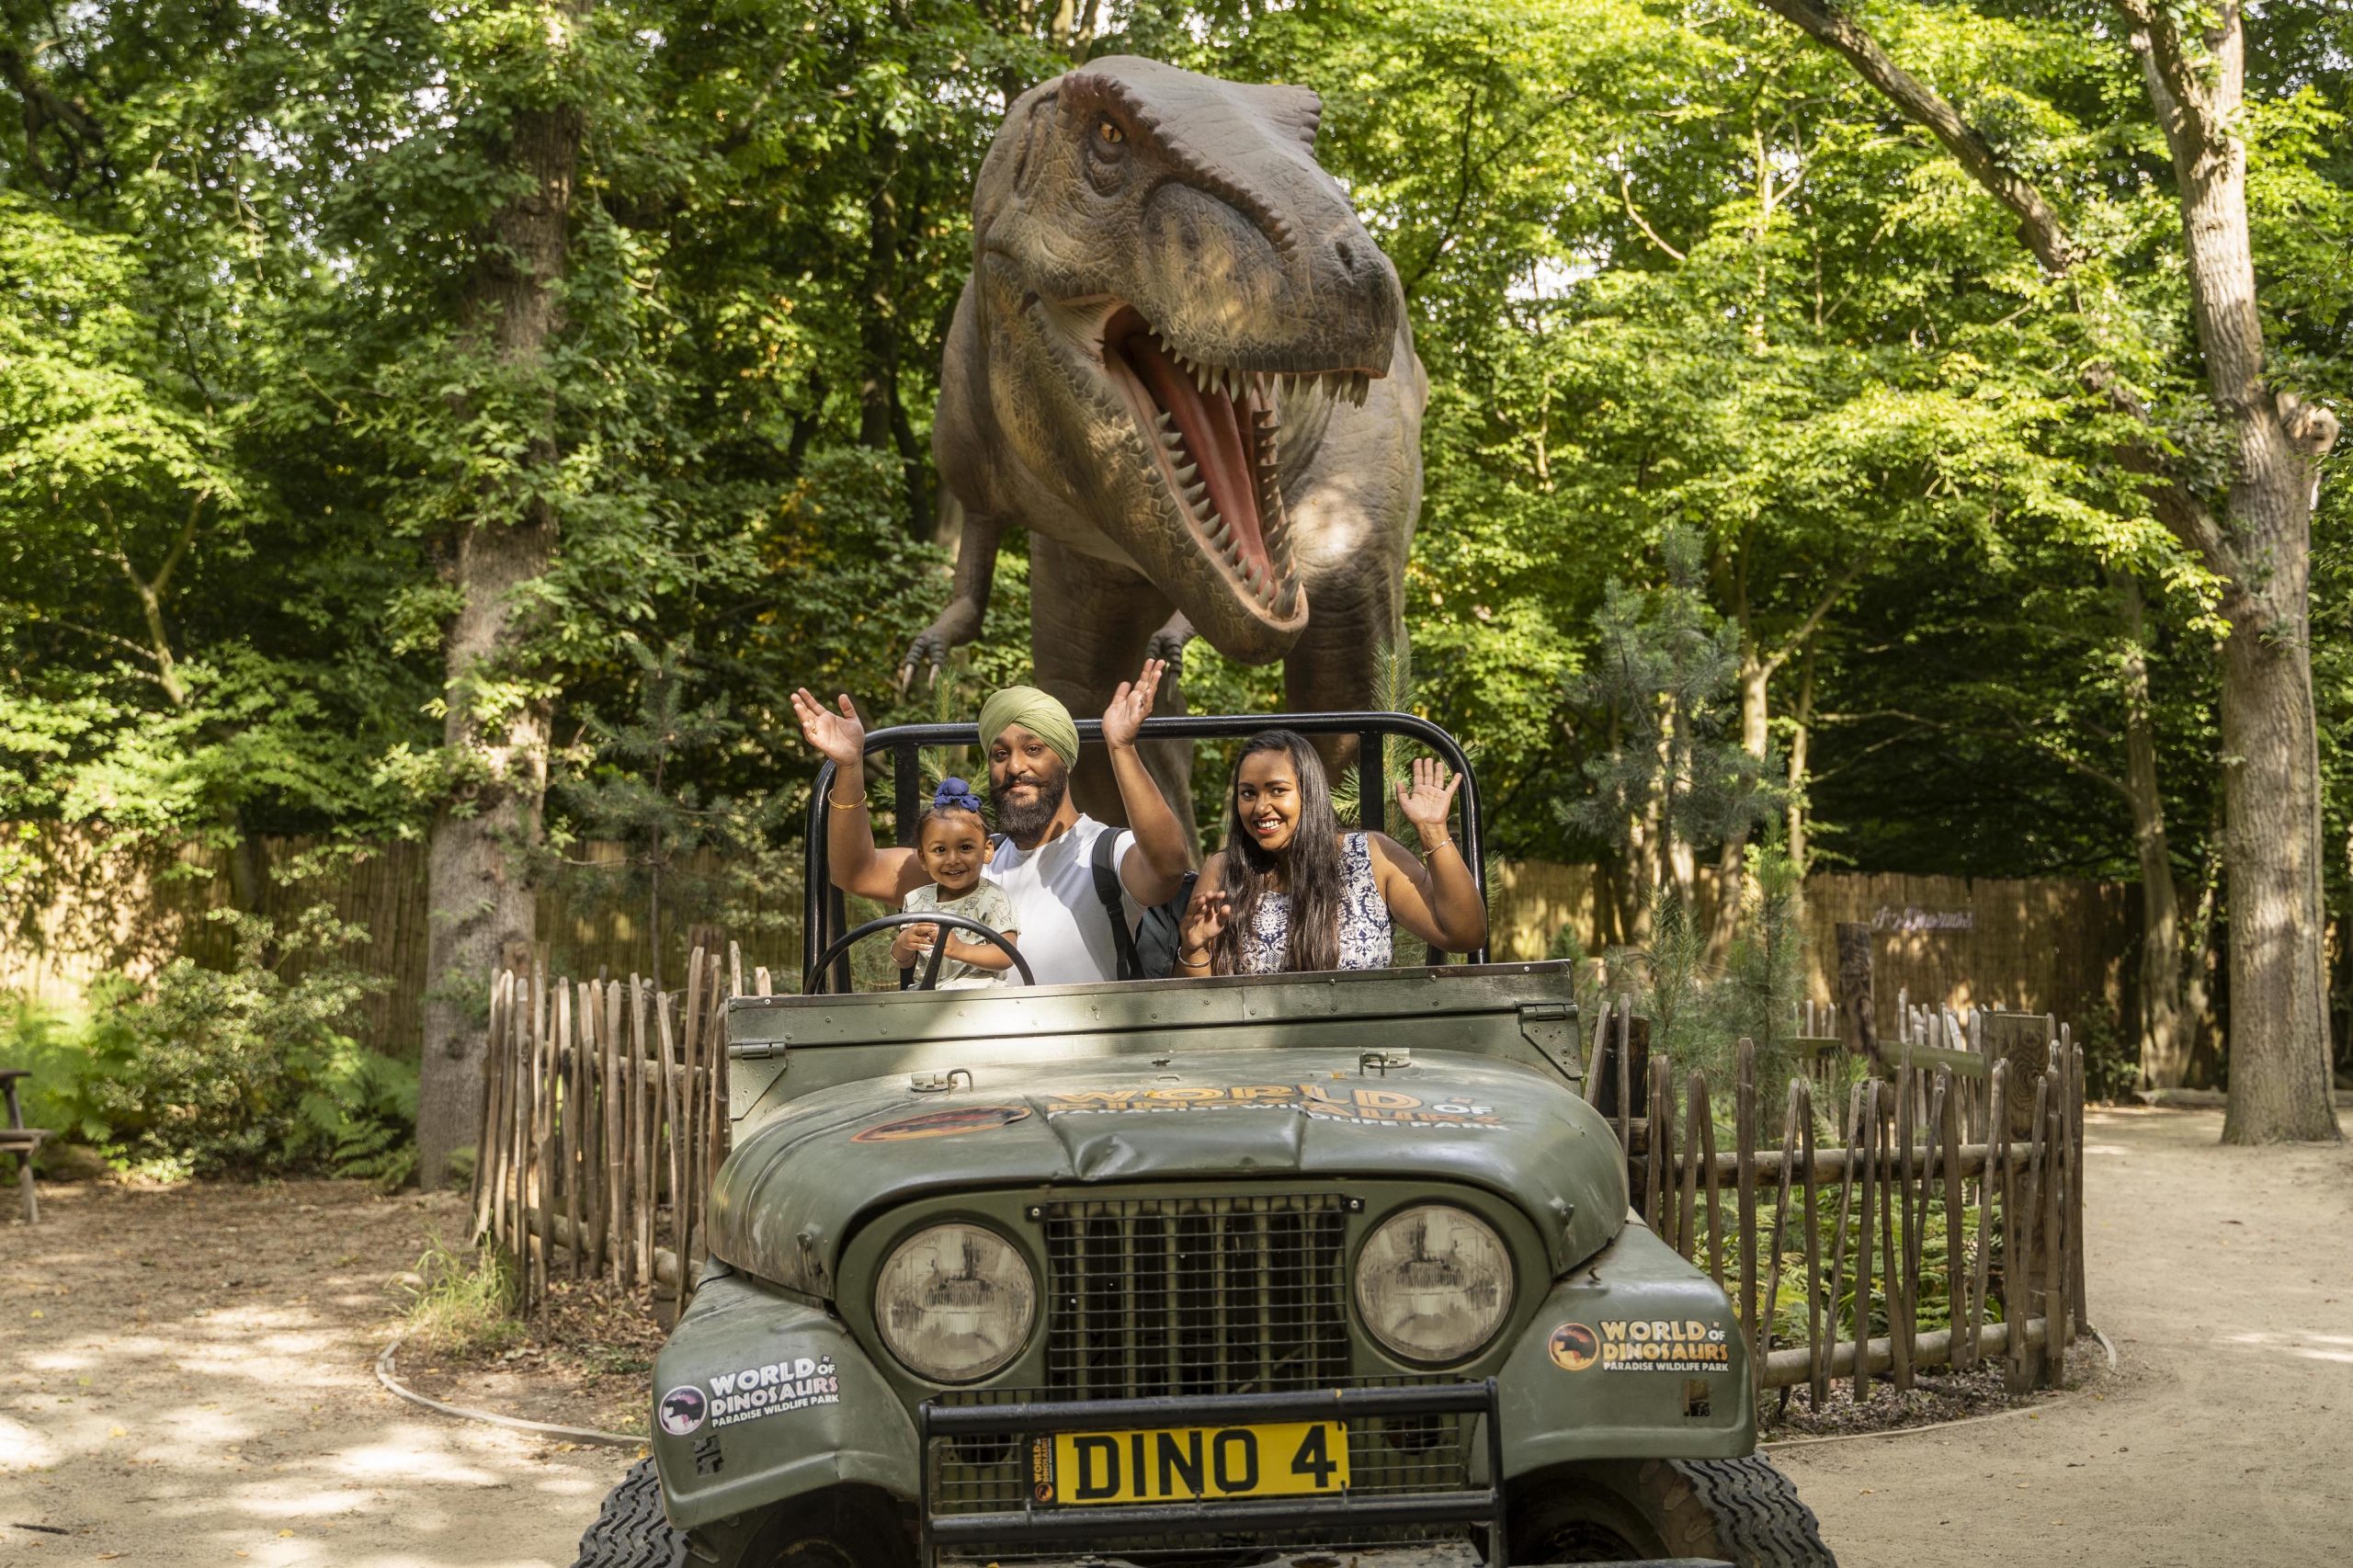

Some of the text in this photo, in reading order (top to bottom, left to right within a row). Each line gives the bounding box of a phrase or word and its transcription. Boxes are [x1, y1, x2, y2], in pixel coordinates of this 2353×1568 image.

[1050, 1085, 1495, 1115] WORLD OF
[1600, 1321, 1725, 1341] WORLD OF
[1603, 1343, 1728, 1360] DINOSAURS
[1603, 1361, 1728, 1371] PARADISE WILDLIFE PARK
[710, 1358, 835, 1397] WORLD OF
[710, 1376, 839, 1417] DINOSAURS
[712, 1394, 840, 1427] PARADISE WILDLIFE PARK
[1033, 1445, 1042, 1483] WORLD
[1074, 1428, 1258, 1500] DINO
[1290, 1425, 1337, 1488] 4
